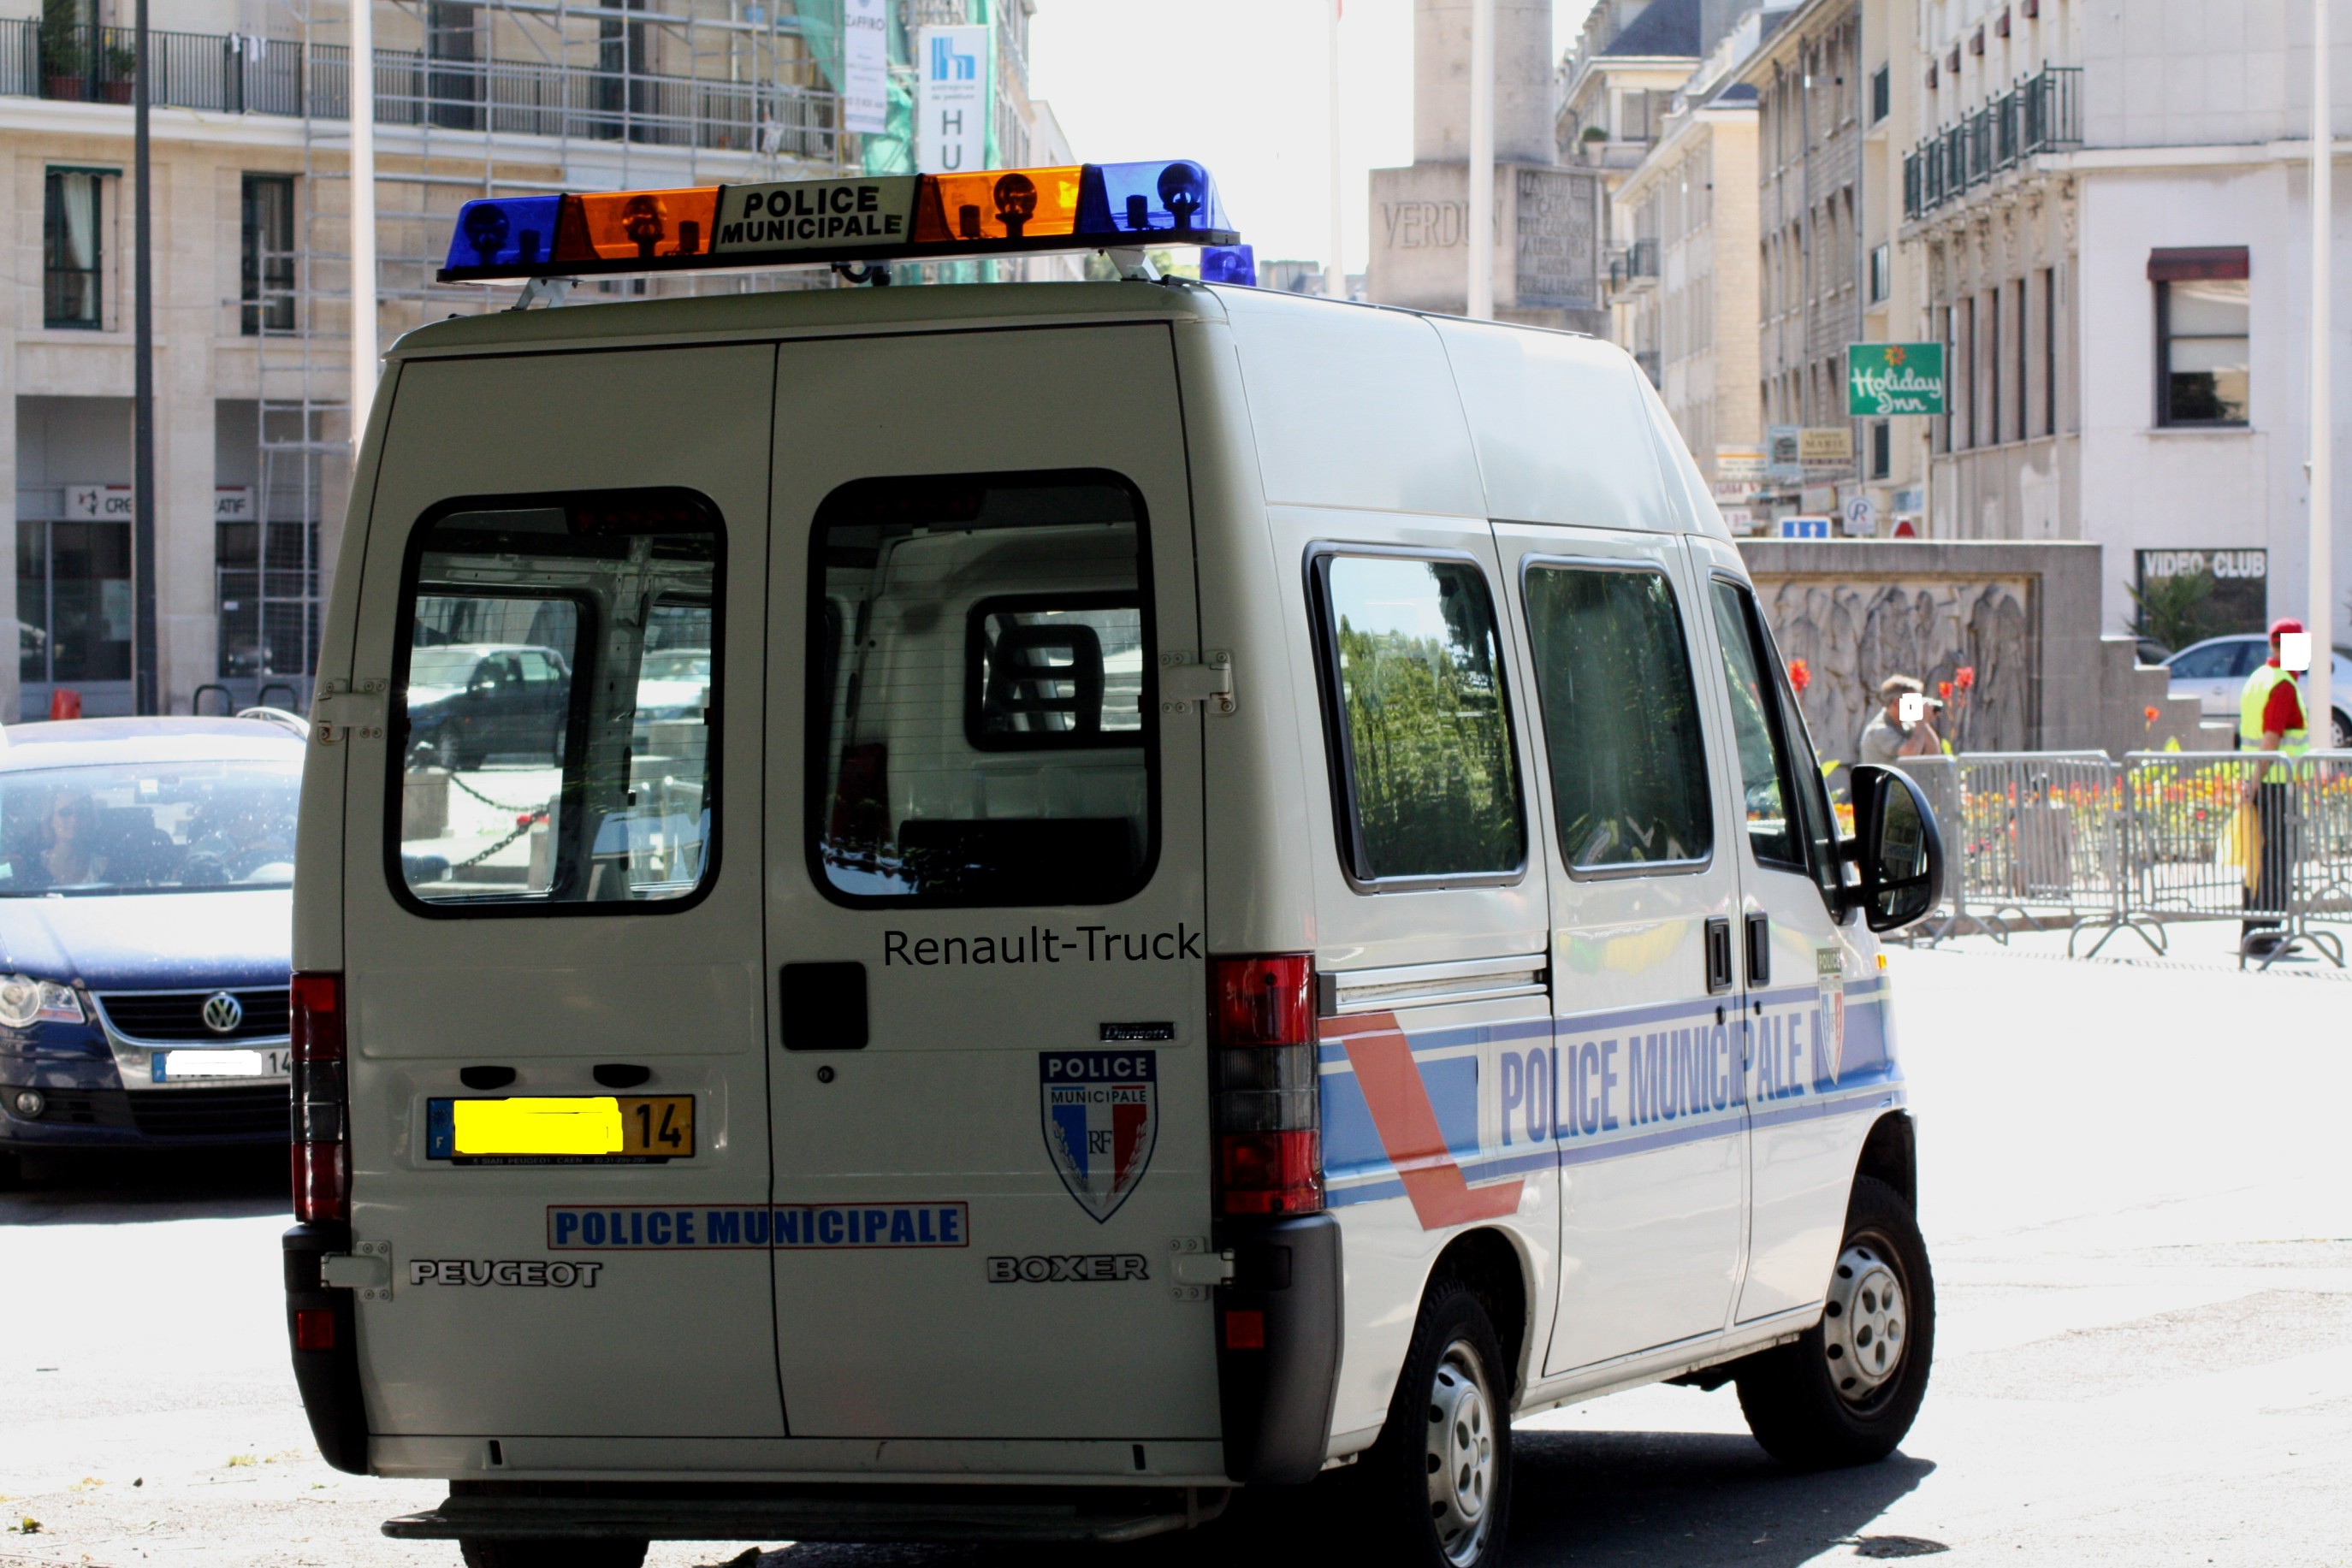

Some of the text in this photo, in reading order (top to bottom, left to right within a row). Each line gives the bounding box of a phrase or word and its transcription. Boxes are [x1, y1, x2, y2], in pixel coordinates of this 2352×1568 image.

[743, 186, 880, 219] POLICE
[720, 214, 903, 245] MUNICIPALE
[1850, 366, 1943, 399] Holiday
[1875, 391, 1928, 414] Inn
[215, 497, 246, 514] ATIF
[2144, 550, 2267, 579] VIDEO CLUB
[1818, 952, 1841, 970] POLICE
[1048, 1056, 1147, 1078] POLICE
[1500, 1011, 1805, 1147] POLICE MUNICIPALE
[1051, 1090, 1147, 1104] MUNICIPALE
[436, 1103, 682, 1149] F 14
[1087, 1130, 1112, 1154] RF
[556, 1208, 960, 1246] POLICE MUNICIPALE
[409, 1258, 603, 1288] PEUGEOT
[986, 1253, 1150, 1283] BOXER
